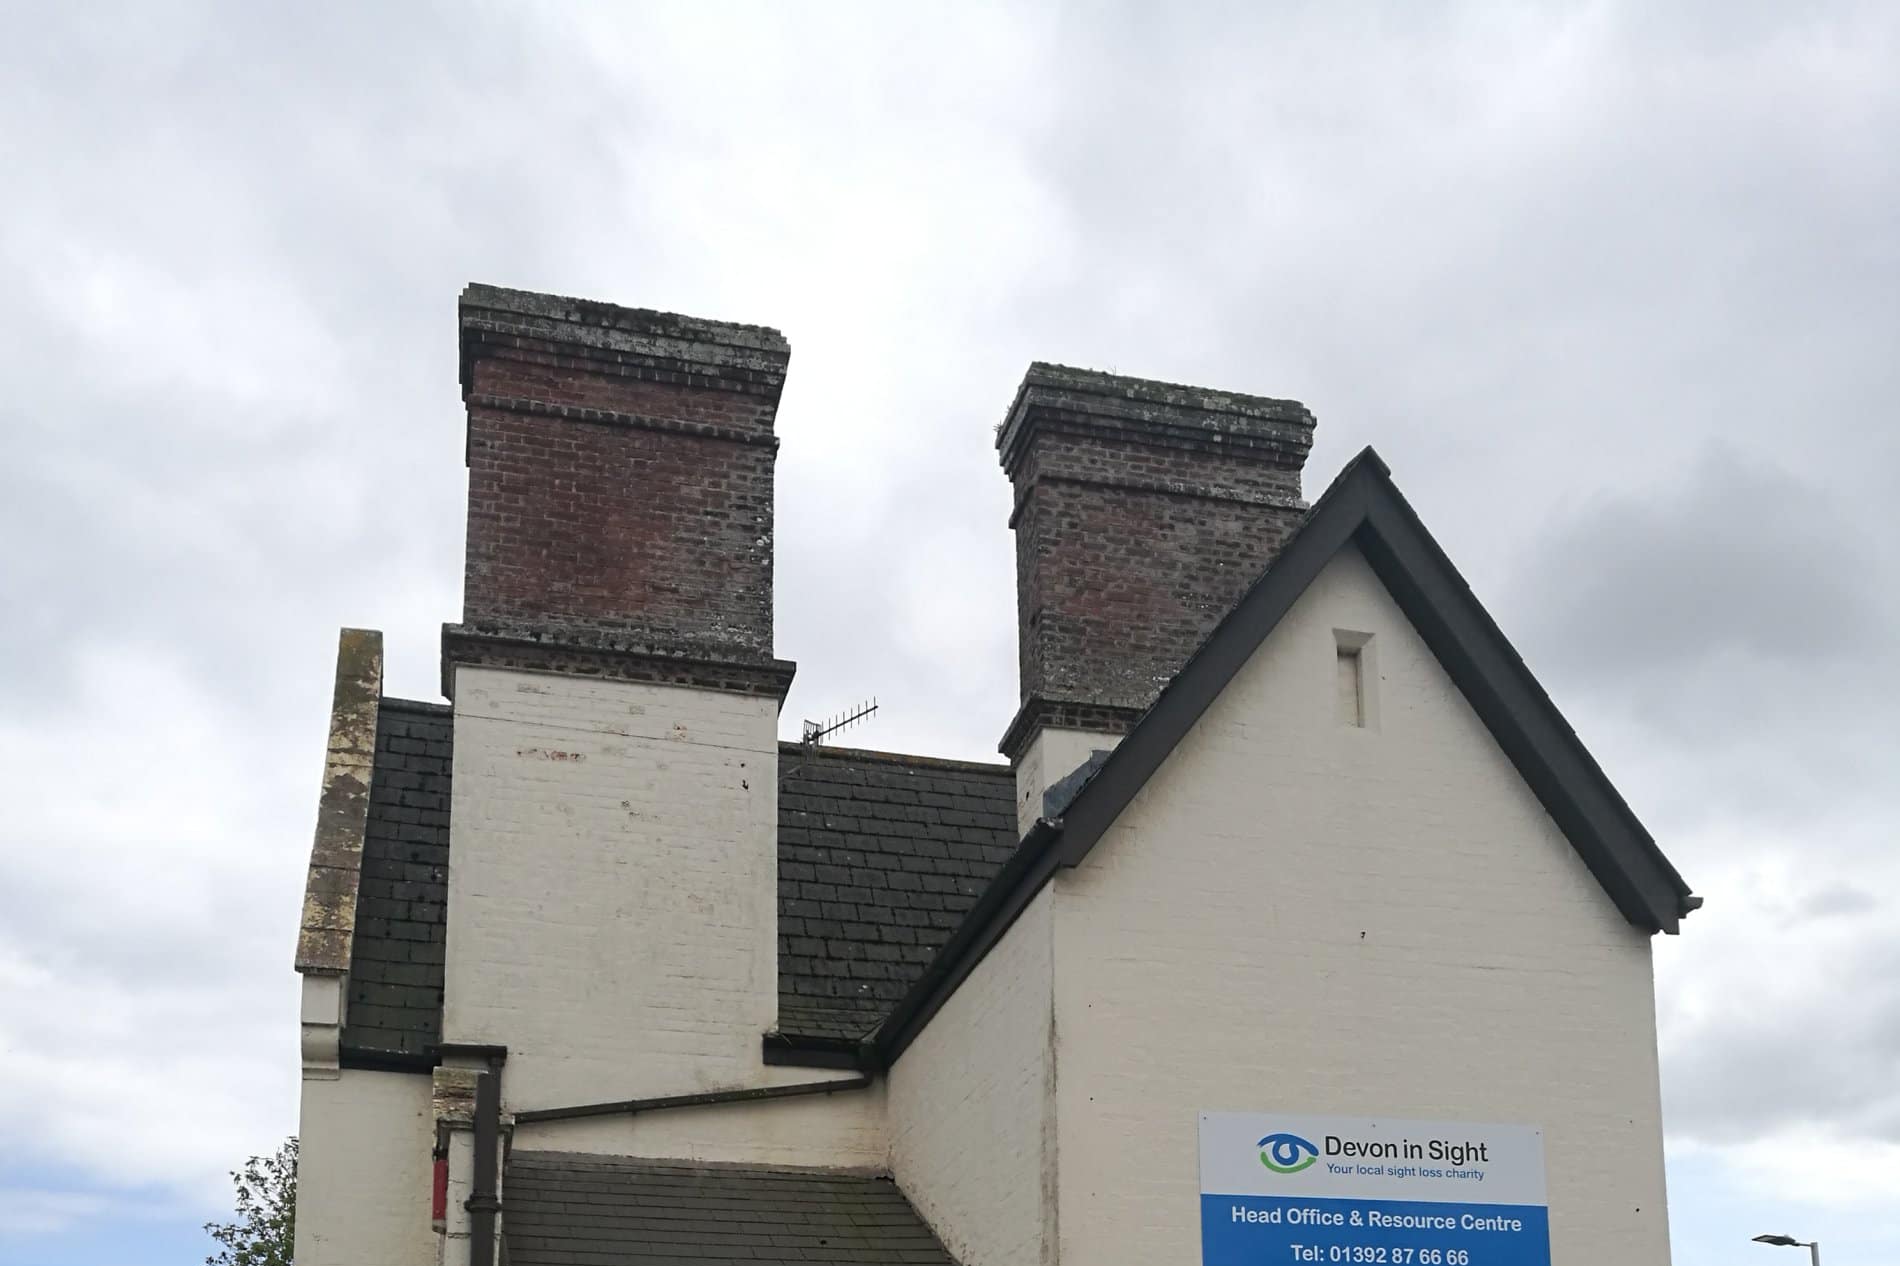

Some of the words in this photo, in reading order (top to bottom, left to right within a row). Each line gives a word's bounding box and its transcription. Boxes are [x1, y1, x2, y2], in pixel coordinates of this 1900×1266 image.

[1325, 1136, 1397, 1158] Devon
[1404, 1139, 1422, 1159] in
[1429, 1140, 1488, 1166] Sight
[1327, 1163, 1352, 1174] Your
[1357, 1164, 1383, 1175] local
[1388, 1166, 1415, 1178] sight
[1419, 1167, 1442, 1178] loss
[1445, 1168, 1484, 1181] charity
[1232, 1207, 1280, 1224] Head
[1286, 1208, 1344, 1226] Office
[1349, 1210, 1363, 1226] &
[1369, 1211, 1455, 1229] Resource
[1461, 1215, 1522, 1231] Centre
[1290, 1244, 1324, 1261] Tel:
[1330, 1246, 1386, 1263] 01392
[1392, 1248, 1414, 1264] 87
[1419, 1249, 1441, 1265] 66
[1446, 1250, 1469, 1266] 66
